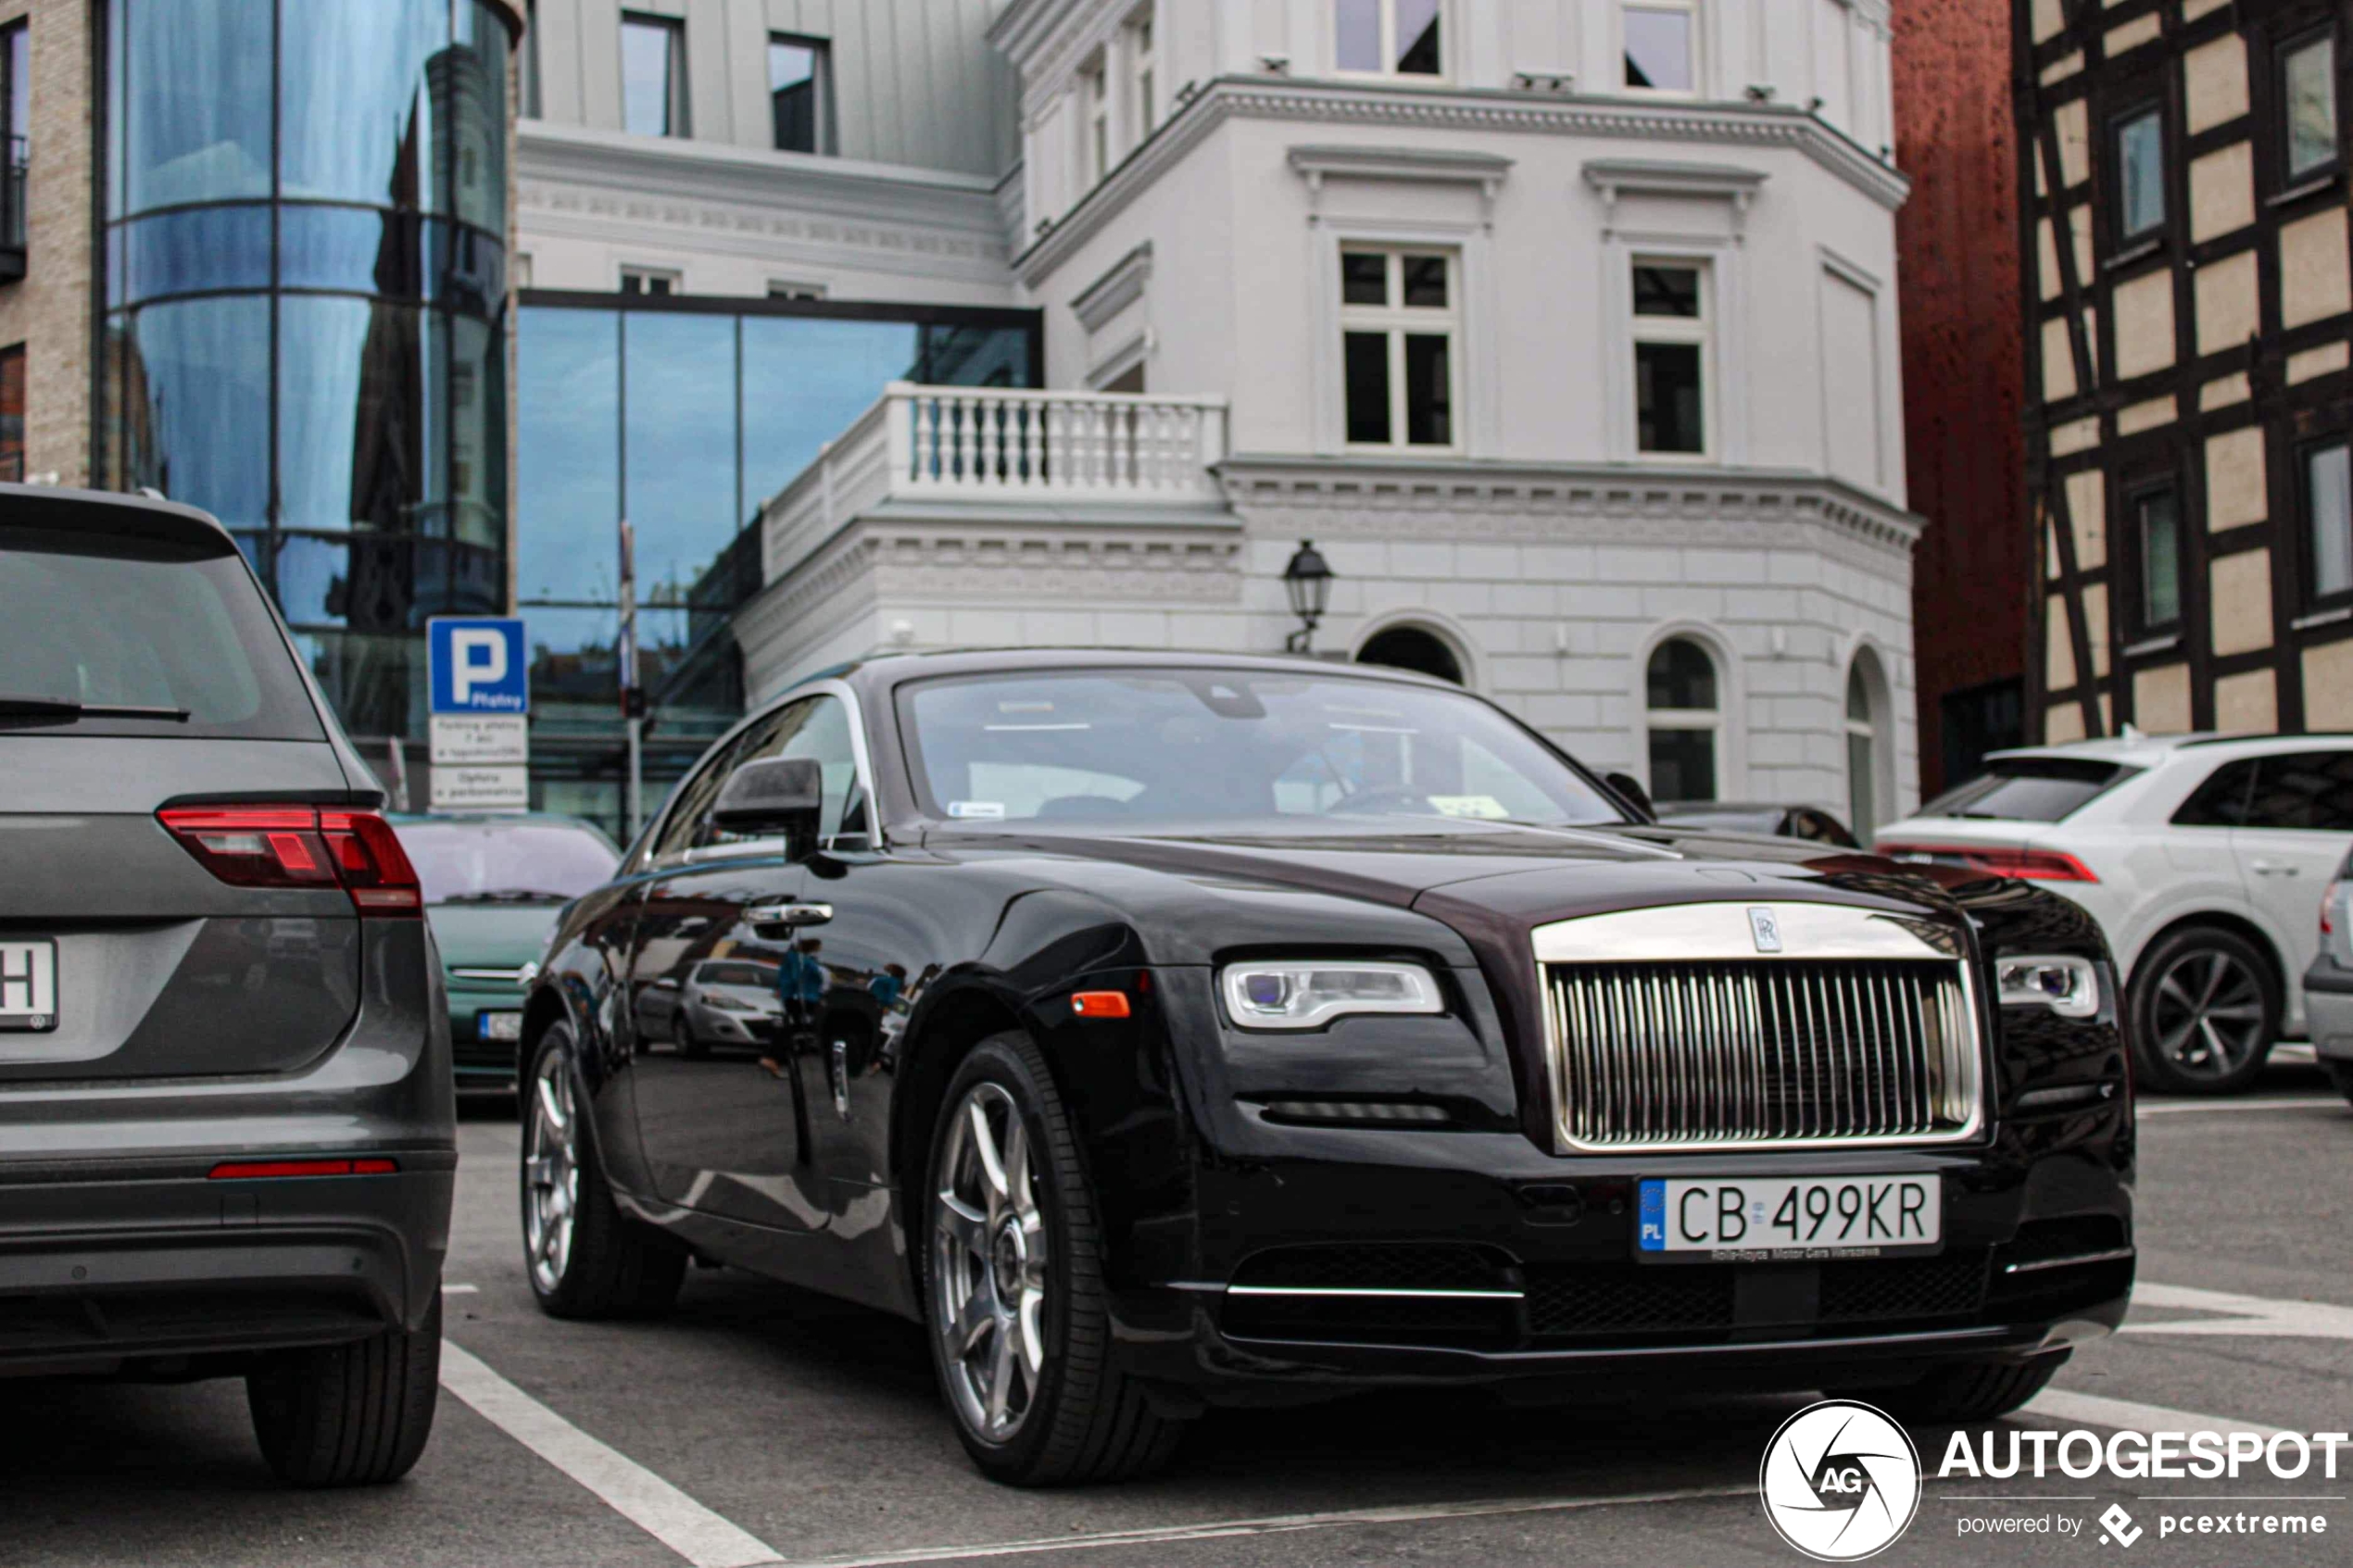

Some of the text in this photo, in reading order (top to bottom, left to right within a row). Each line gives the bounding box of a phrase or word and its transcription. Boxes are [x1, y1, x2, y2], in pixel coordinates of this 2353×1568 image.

[451, 628, 509, 705] P
[1642, 1223, 1662, 1240] PL
[1680, 1183, 1926, 1243] CB 499KR
[1772, 1248, 1805, 1261] Motor
[1806, 1248, 1830, 1260] Cars
